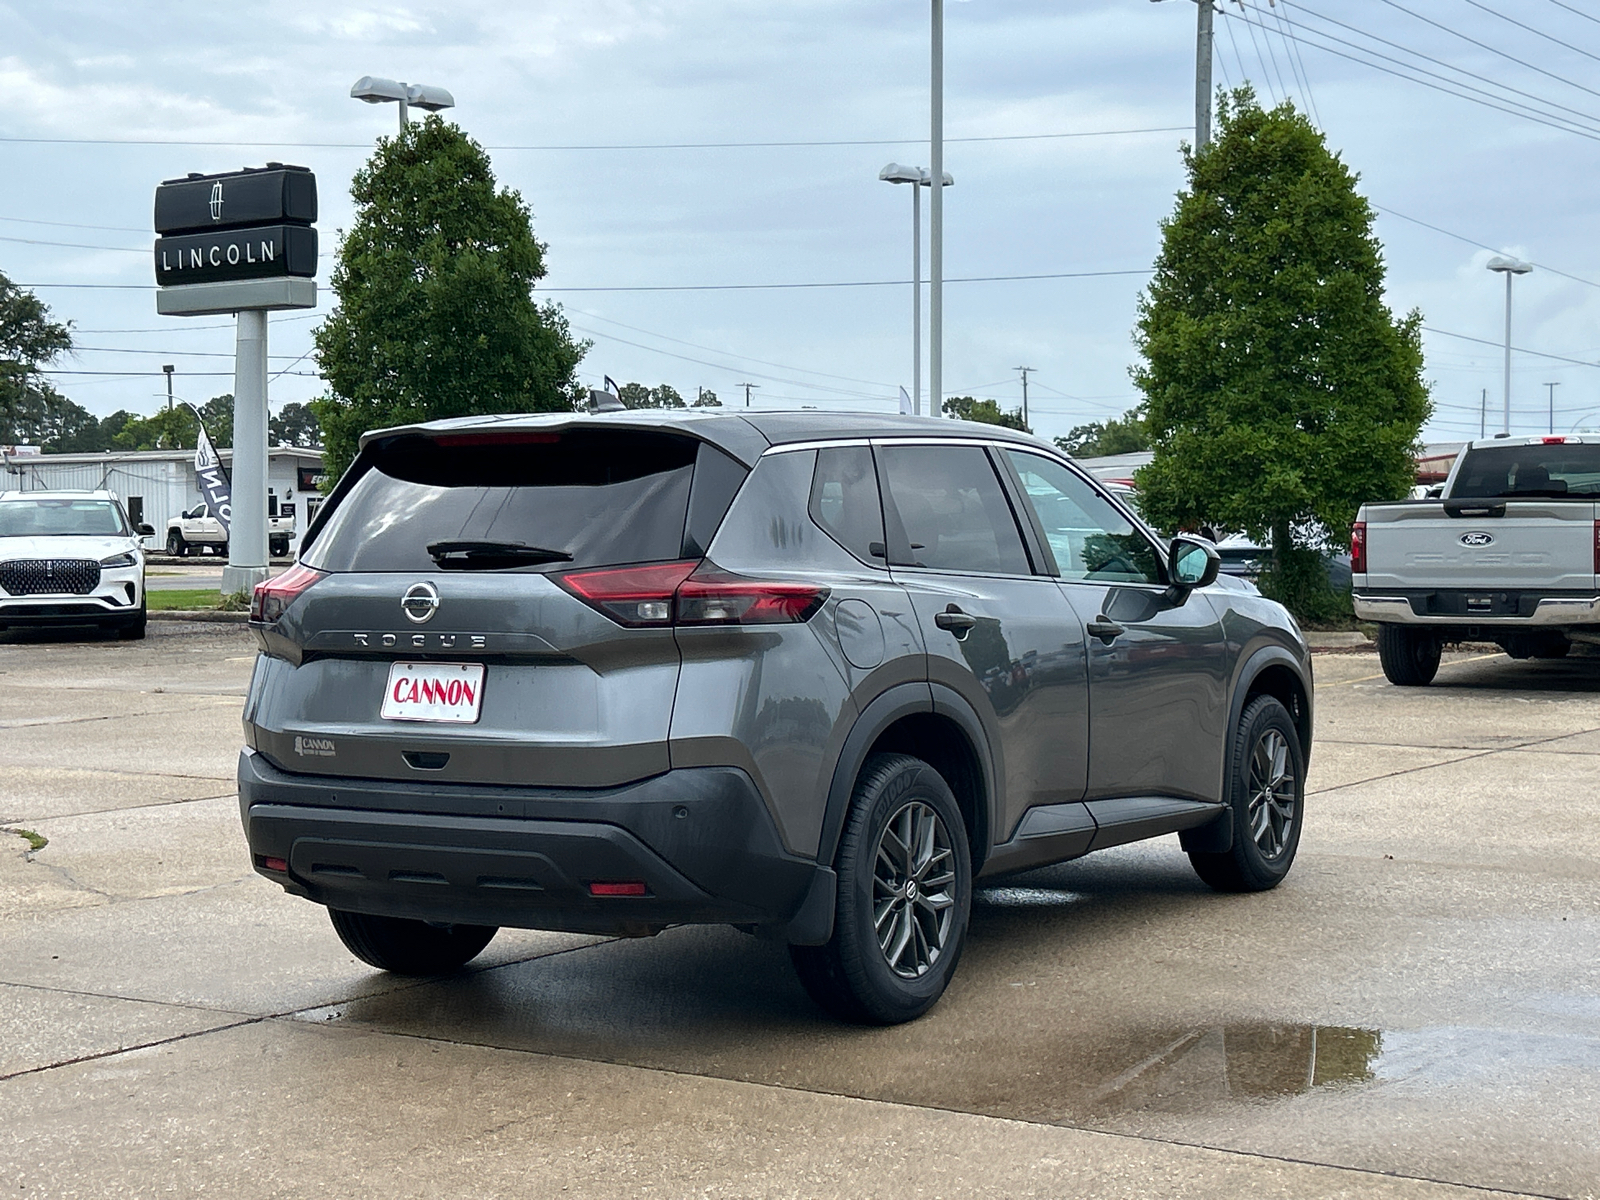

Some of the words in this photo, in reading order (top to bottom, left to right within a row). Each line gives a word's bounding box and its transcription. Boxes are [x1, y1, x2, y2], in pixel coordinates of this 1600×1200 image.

[162, 240, 275, 271] LINCOLN
[1464, 533, 1488, 544] Ford
[353, 633, 486, 649] ROGUE
[393, 677, 477, 707] CANNON
[302, 737, 336, 751] CANNON
